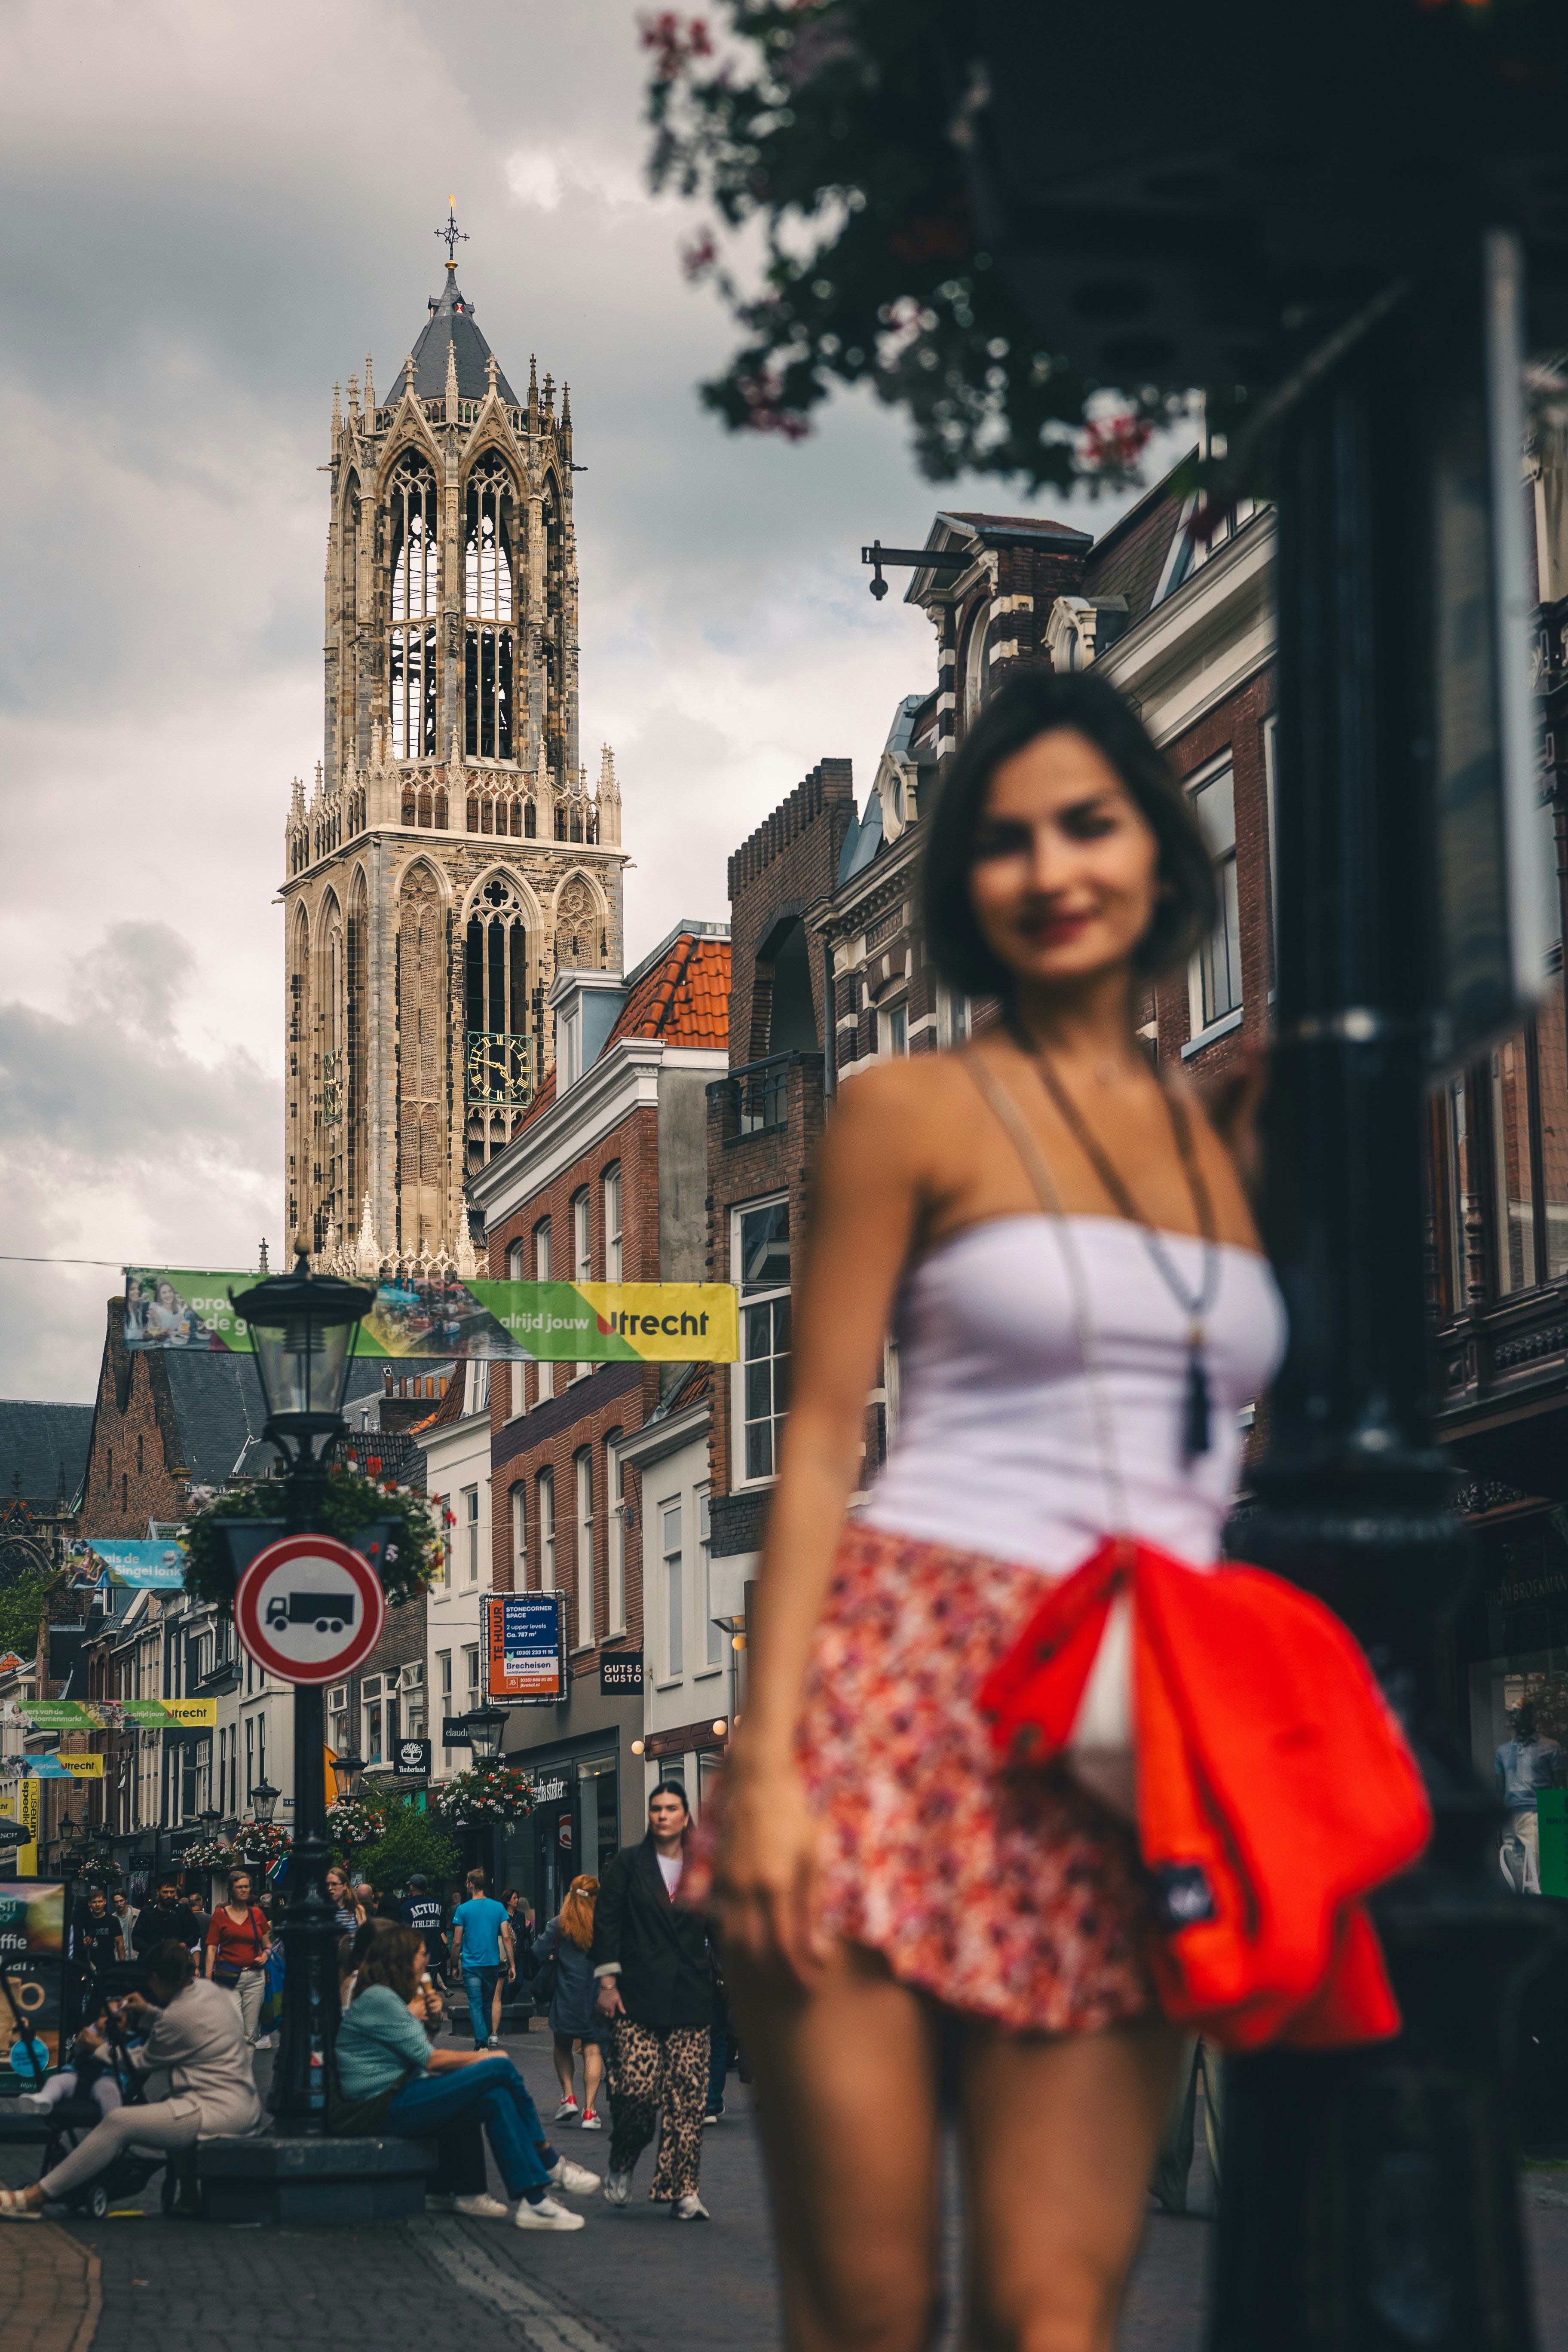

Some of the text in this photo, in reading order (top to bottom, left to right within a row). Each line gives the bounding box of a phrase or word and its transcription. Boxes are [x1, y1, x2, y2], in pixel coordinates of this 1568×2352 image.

[205, 1313, 230, 1330] de
[500, 1310, 709, 1335] altijd jouw Utrecht
[104, 1553, 140, 1564] als de
[115, 1565, 152, 1578] Singel
[494, 1606, 503, 1662] TE HUUR
[604, 1664, 641, 1673] GUTS &
[604, 1675, 641, 1683] GUSTO
[167, 1709, 207, 1718] Utrecht
[61, 1762, 95, 1770] Utrecht
[547, 1777, 564, 1801] sträter
[1546, 1817, 1568, 1825] BRO
